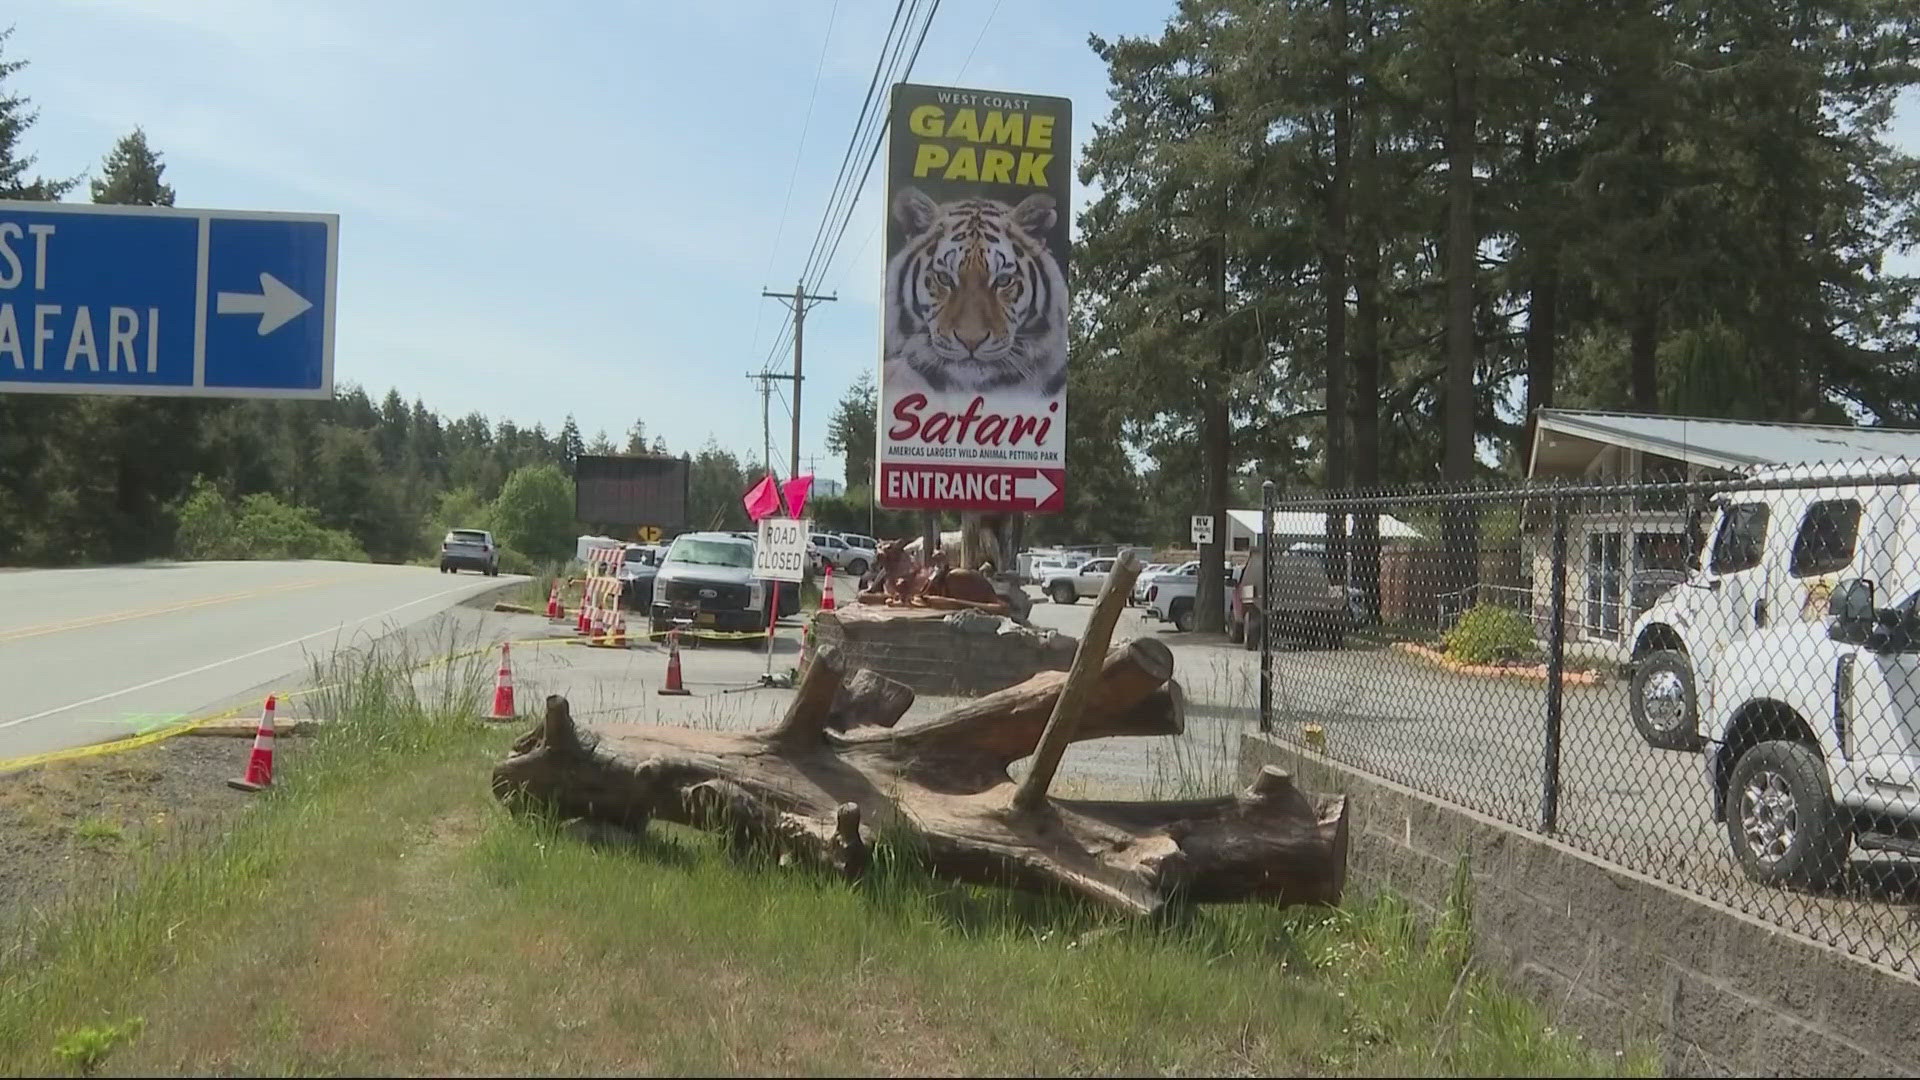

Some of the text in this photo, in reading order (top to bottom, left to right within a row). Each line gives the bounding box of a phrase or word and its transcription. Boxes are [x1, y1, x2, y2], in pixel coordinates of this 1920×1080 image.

[938, 91, 1030, 111] WEST COAST
[909, 105, 1056, 149] GAME
[913, 144, 1055, 187] PARK
[0, 302, 159, 373] AFARI
[888, 393, 1059, 447] Safari
[888, 446, 1058, 461] AMERICAS LARGEST WILD ANIMAL PETTING PARK
[888, 471, 1011, 501] ENTRANCE
[766, 527, 797, 544] ROAD
[757, 552, 801, 571] CLOSED
